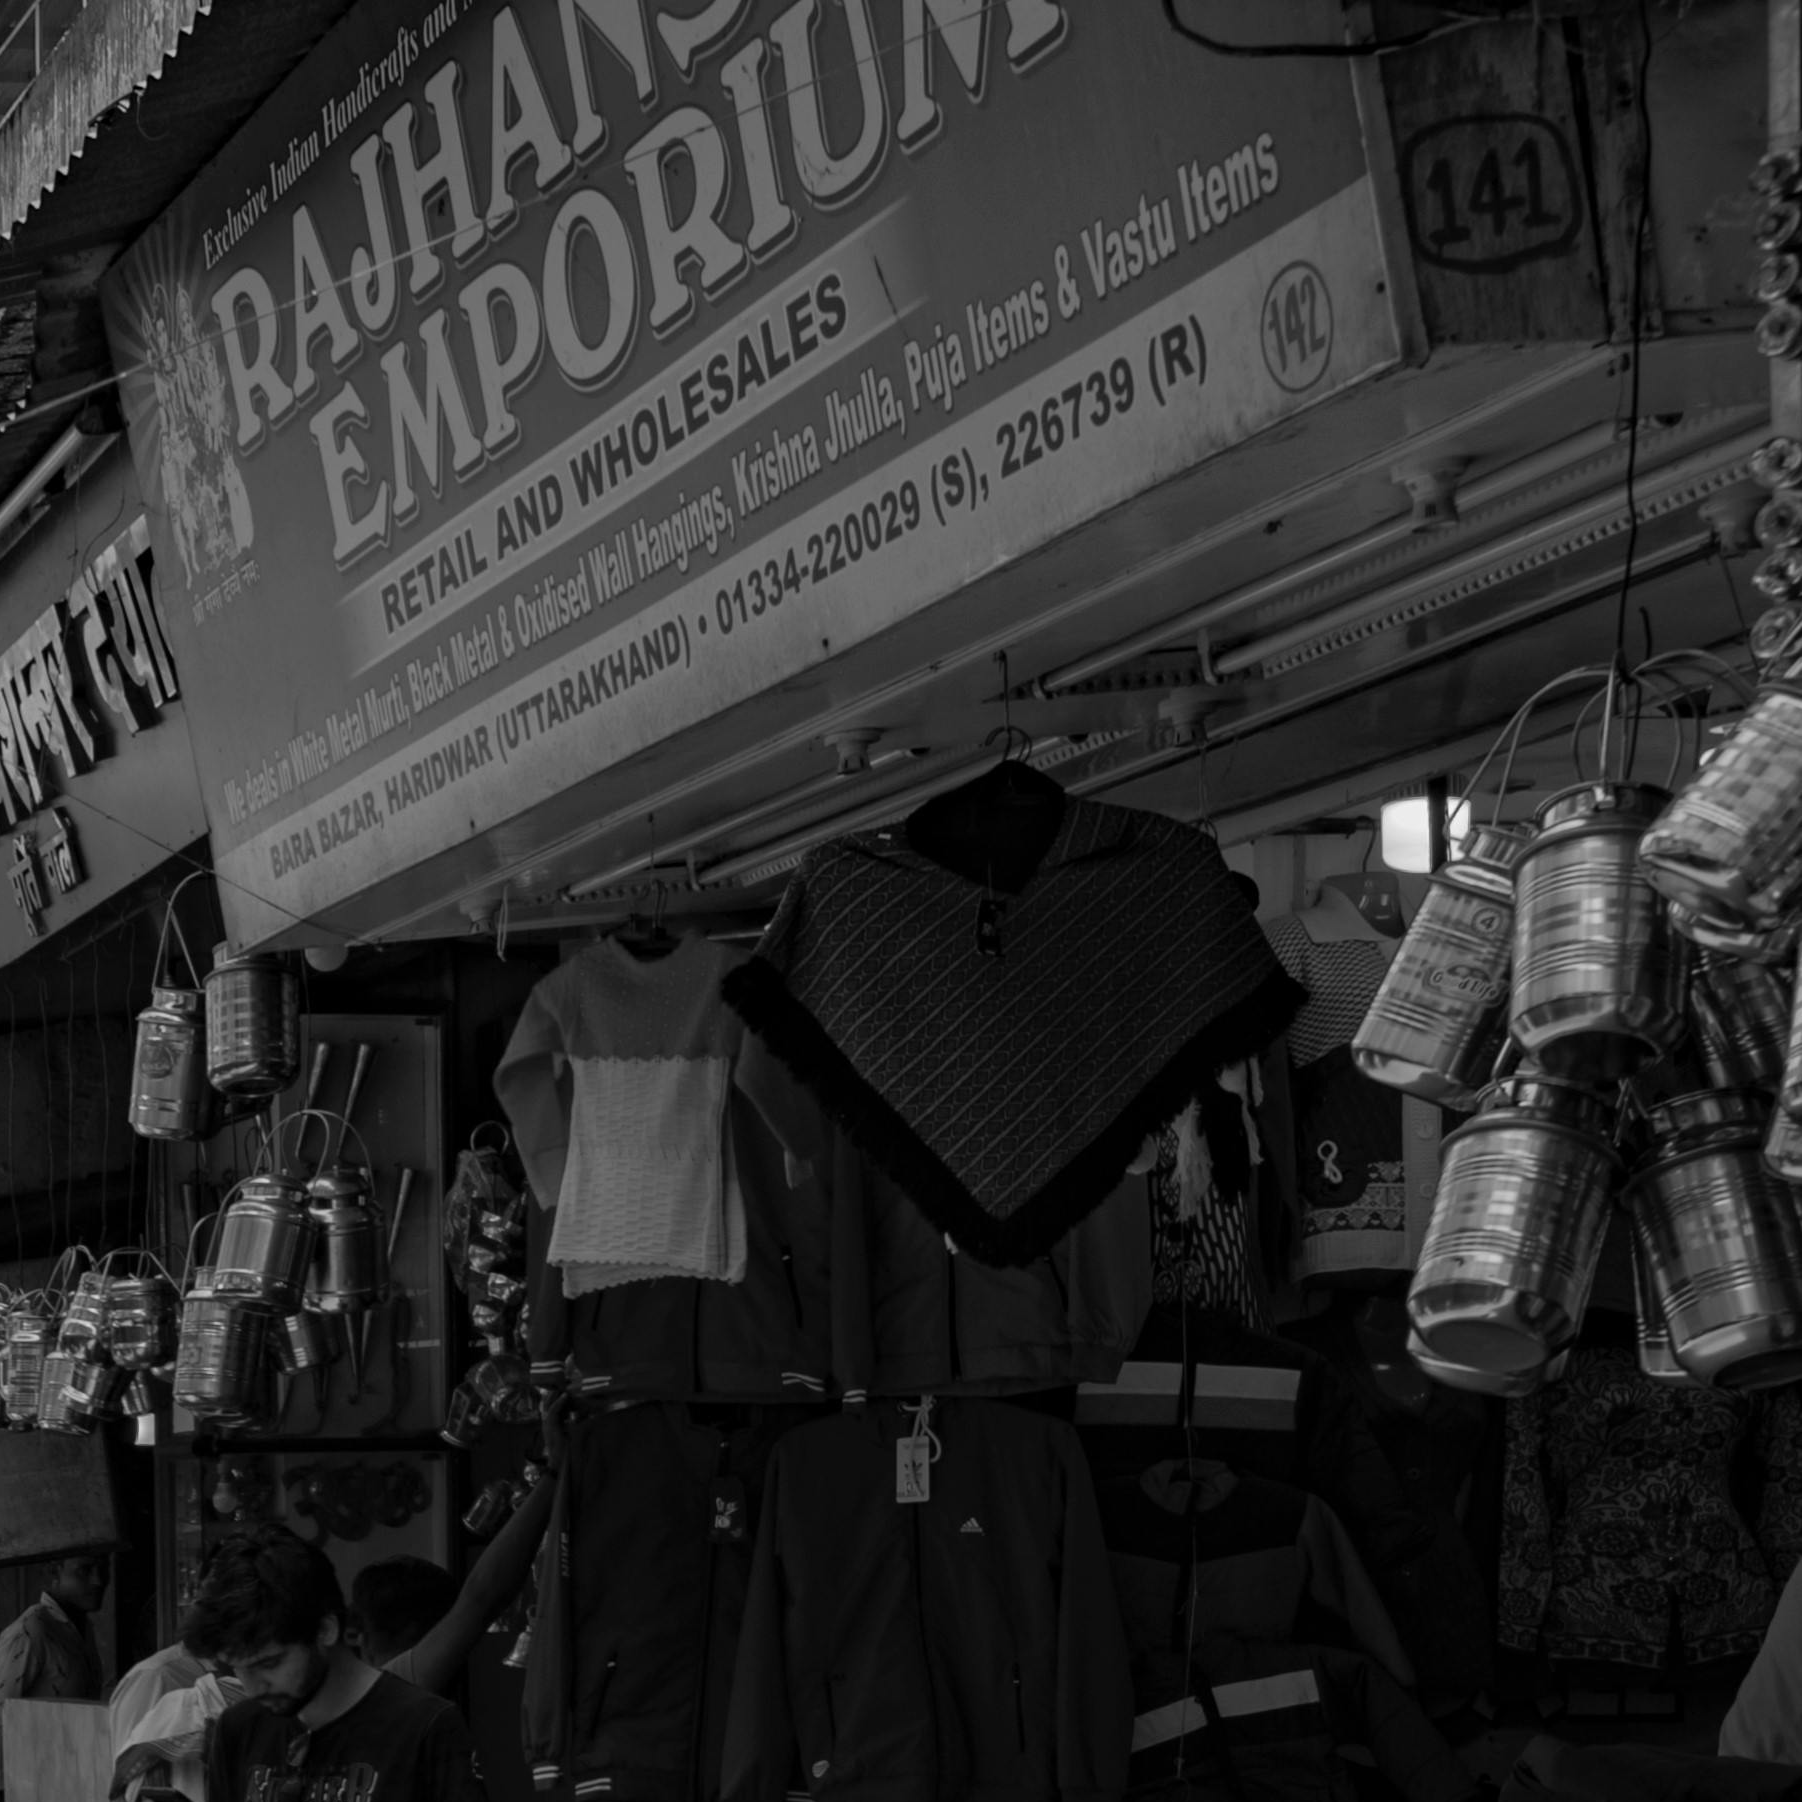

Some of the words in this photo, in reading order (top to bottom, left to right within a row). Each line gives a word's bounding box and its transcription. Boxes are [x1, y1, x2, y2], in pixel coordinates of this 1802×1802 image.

[202, 184, 268, 271] Exclusive
[268, 130, 321, 203] Indian
[321, 26, 419, 149] Handicrafts
[308, 0, 1068, 573] EMPORIUM
[1265, 274, 1327, 375] 142
[1424, 136, 1562, 246] 141
[223, 779, 247, 825] We
[246, 758, 279, 815] deals
[275, 749, 294, 795] in
[288, 729, 330, 786] White
[325, 696, 369, 765] Metal
[363, 672, 412, 739] Murti,
[406, 645, 456, 715] Black
[450, 613, 500, 689] Metal
[498, 604, 516, 660] &
[514, 556, 592, 648] Oxidised
[588, 529, 634, 604] Wall
[631, 485, 737, 580] Hangings,
[731, 424, 821, 517] Krishna
[823, 365, 908, 464] Jhulla,
[902, 323, 968, 413] Puja
[965, 277, 1051, 373] Items
[1053, 243, 1083, 320] &
[1080, 191, 1176, 300] Vastu
[1175, 131, 1279, 242] Items
[269, 829, 318, 880] BARA
[317, 790, 384, 851] BAZAR,
[383, 725, 494, 816] HARIDWAR
[494, 614, 692, 765] (UTTARAKHAND)
[713, 479, 921, 636] 01334-220029
[930, 447, 991, 526] (S),
[995, 355, 1136, 480] 226739
[1147, 314, 1208, 406] (R)
[380, 529, 488, 634] RETAIL
[496, 475, 564, 560] AND
[568, 273, 847, 508] WHOLESALES
